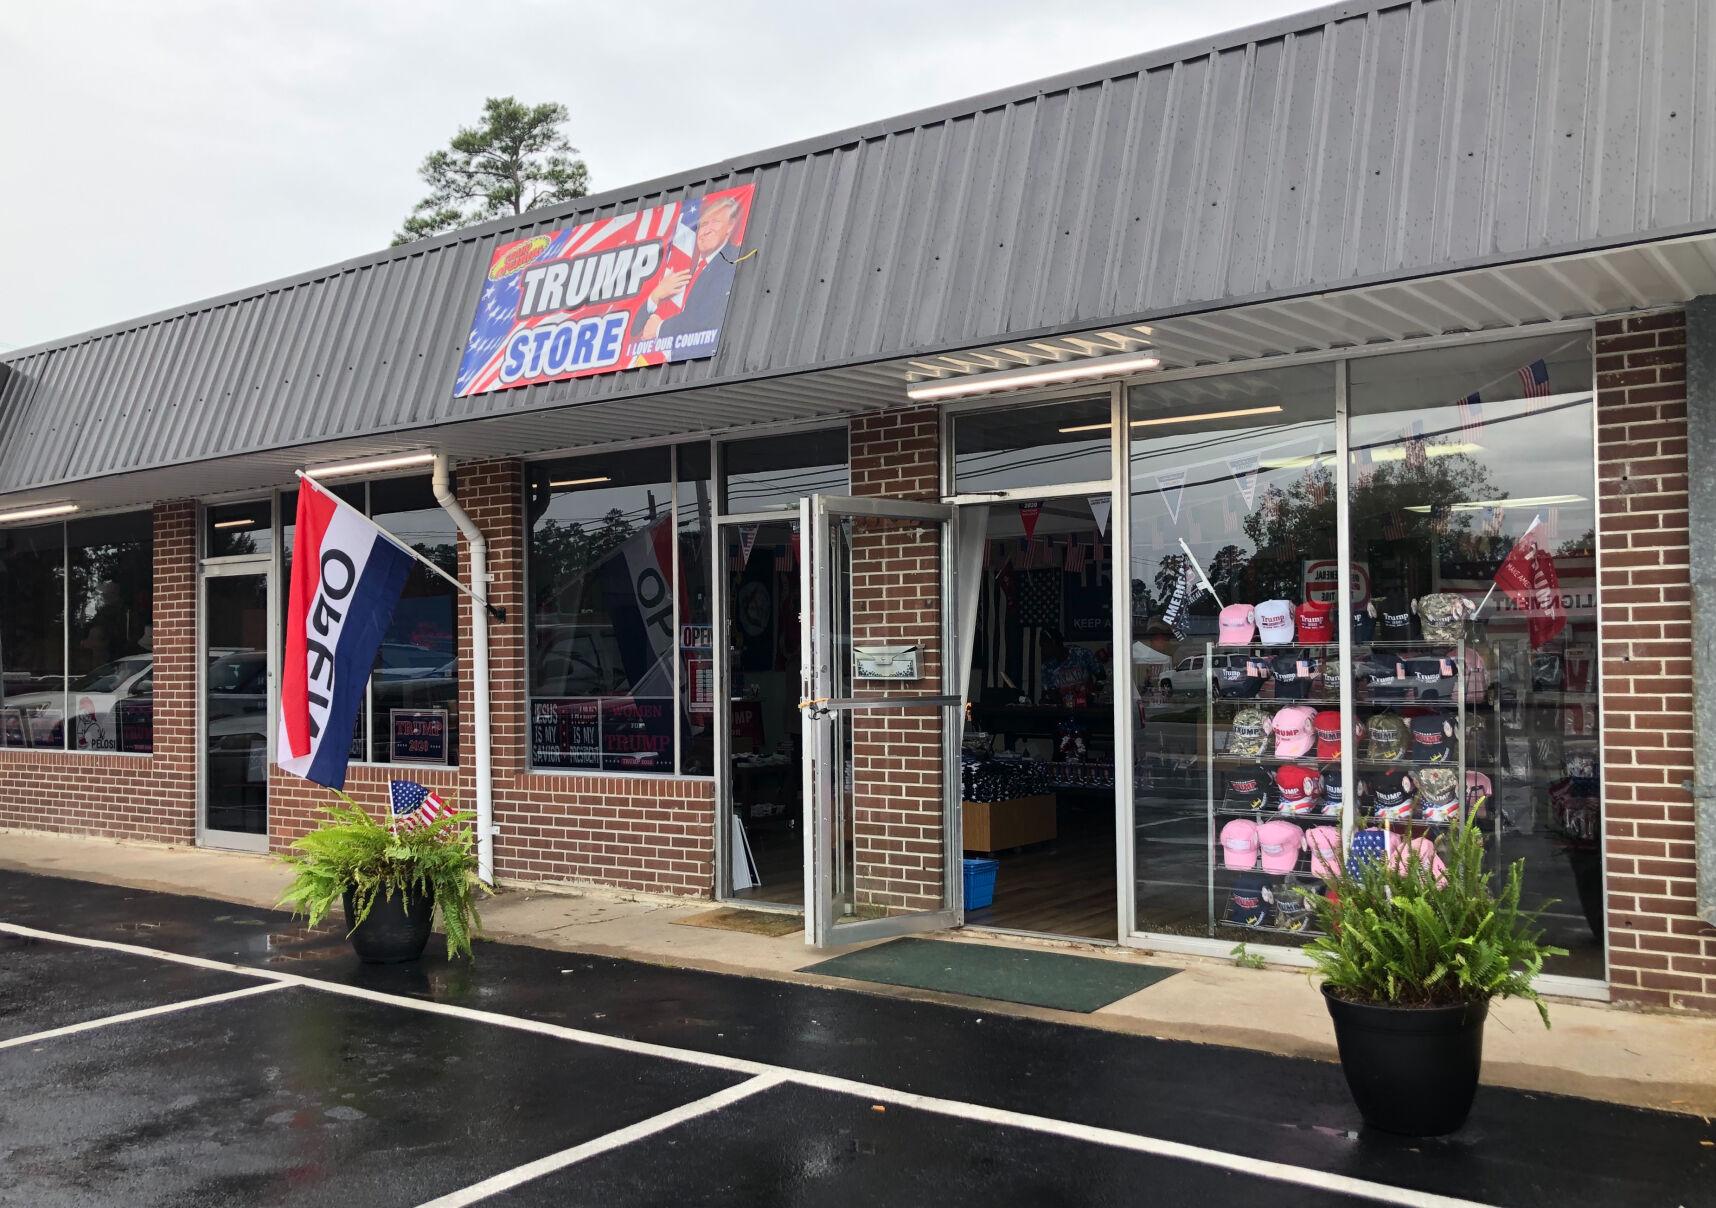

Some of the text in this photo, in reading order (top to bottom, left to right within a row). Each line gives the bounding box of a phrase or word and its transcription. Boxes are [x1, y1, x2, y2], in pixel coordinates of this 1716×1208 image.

[519, 242, 661, 316] TRUMP
[502, 316, 627, 378] STORE
[627, 329, 718, 356] I LOVE OUR COUNTRY
[1262, 615, 1285, 624] Trump
[1299, 615, 1324, 624] Trump
[1383, 613, 1409, 622] Trump
[1222, 669, 1241, 678] Trump
[1369, 674, 1395, 683] Trump
[1414, 671, 1441, 681] Trump
[396, 720, 443, 737] TRUMP
[535, 725, 557, 743] IS MY
[1233, 725, 1261, 736] TRUMP
[573, 726, 595, 743] IS MY
[91, 738, 116, 750] PELOSI
[605, 734, 671, 753] TRUMP
[1376, 790, 1402, 801] TRUMP
